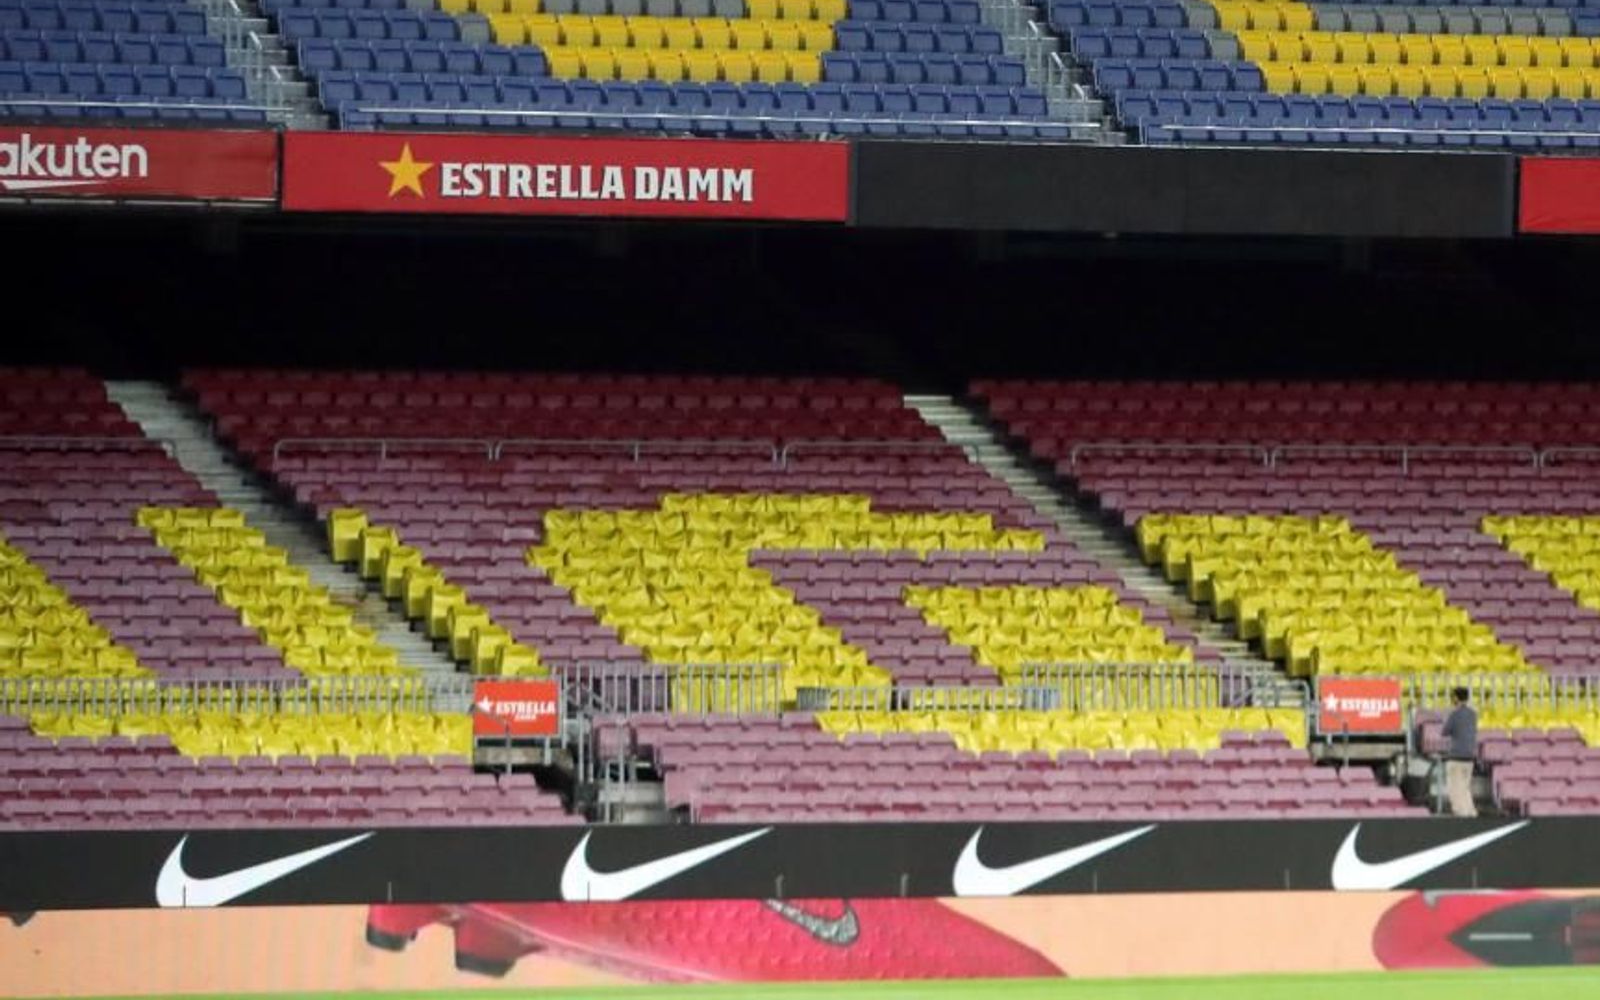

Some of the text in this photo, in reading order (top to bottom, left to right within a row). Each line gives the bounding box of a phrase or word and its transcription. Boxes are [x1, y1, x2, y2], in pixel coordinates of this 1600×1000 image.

[441, 162, 754, 202] ESTRELLA DAMM
[496, 701, 555, 714] ESTRELLA
